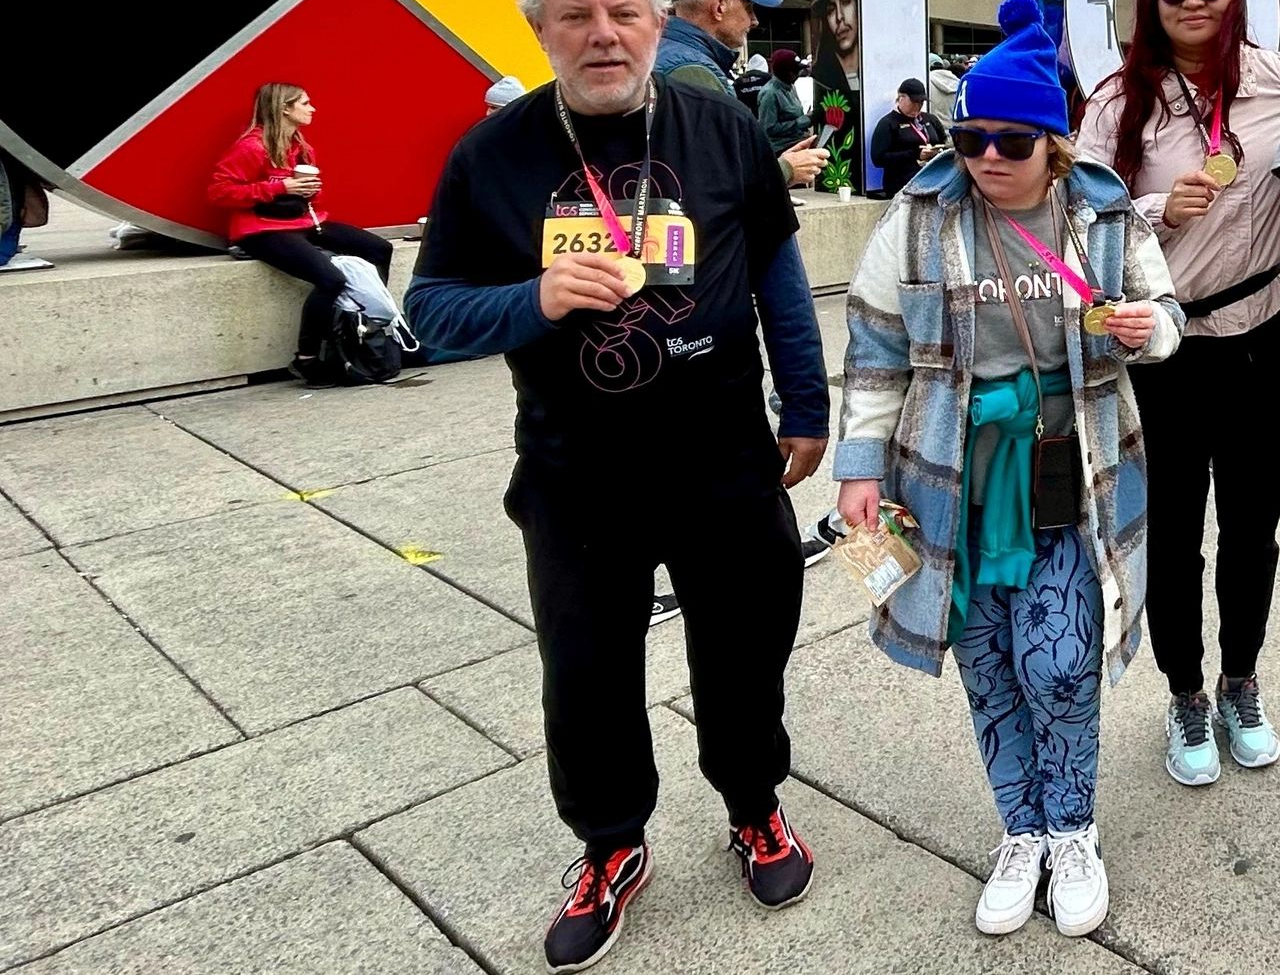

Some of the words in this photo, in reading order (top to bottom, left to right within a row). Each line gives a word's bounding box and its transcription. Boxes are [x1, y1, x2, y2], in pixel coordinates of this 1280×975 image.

[637, 178, 648, 216] MARATHON
[556, 204, 578, 216] tcs
[553, 232, 632, 255] 2632
[974, 272, 1062, 303] ORONT
[1054, 315, 1064, 323] tc
[666, 337, 683, 347] tcs
[667, 335, 713, 355] TORONTO
